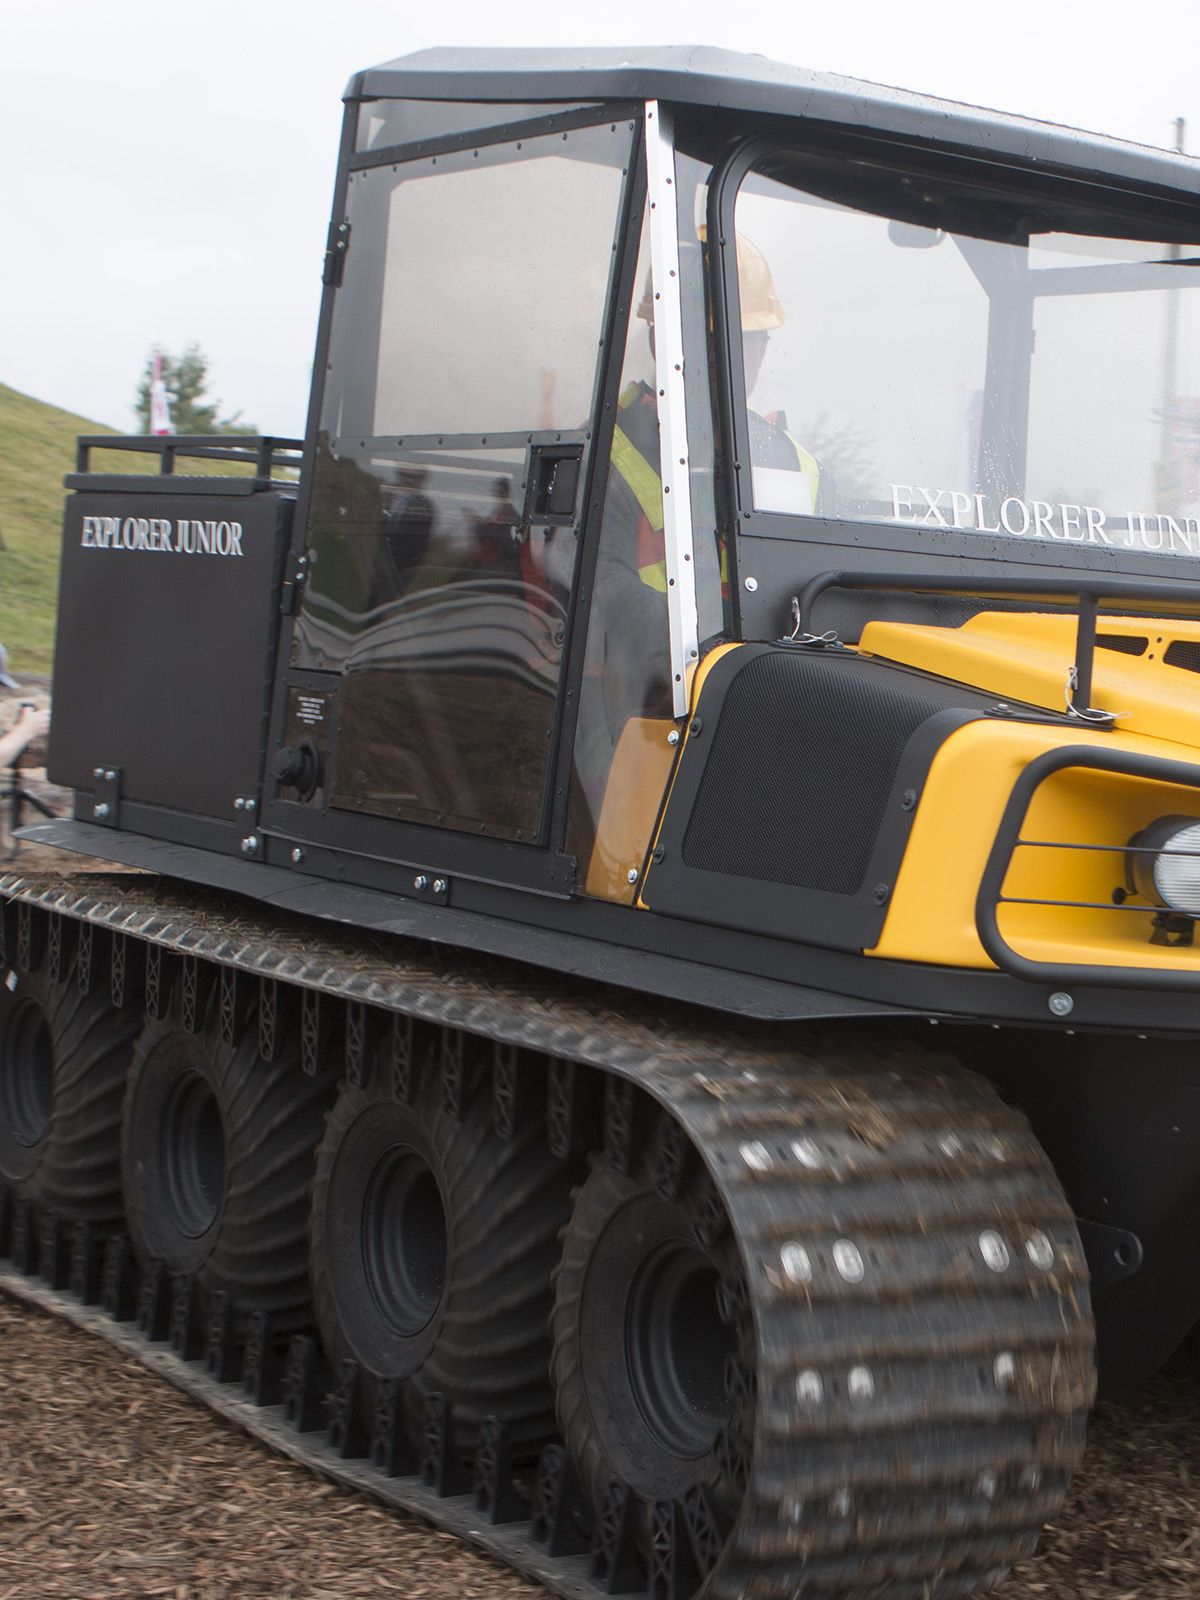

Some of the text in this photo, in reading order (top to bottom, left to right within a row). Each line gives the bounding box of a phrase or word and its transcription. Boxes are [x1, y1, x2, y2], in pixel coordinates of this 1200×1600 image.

[80, 516, 244, 556] EXPLORER JUNIOR
[888, 483, 1114, 546] EXPLORER
